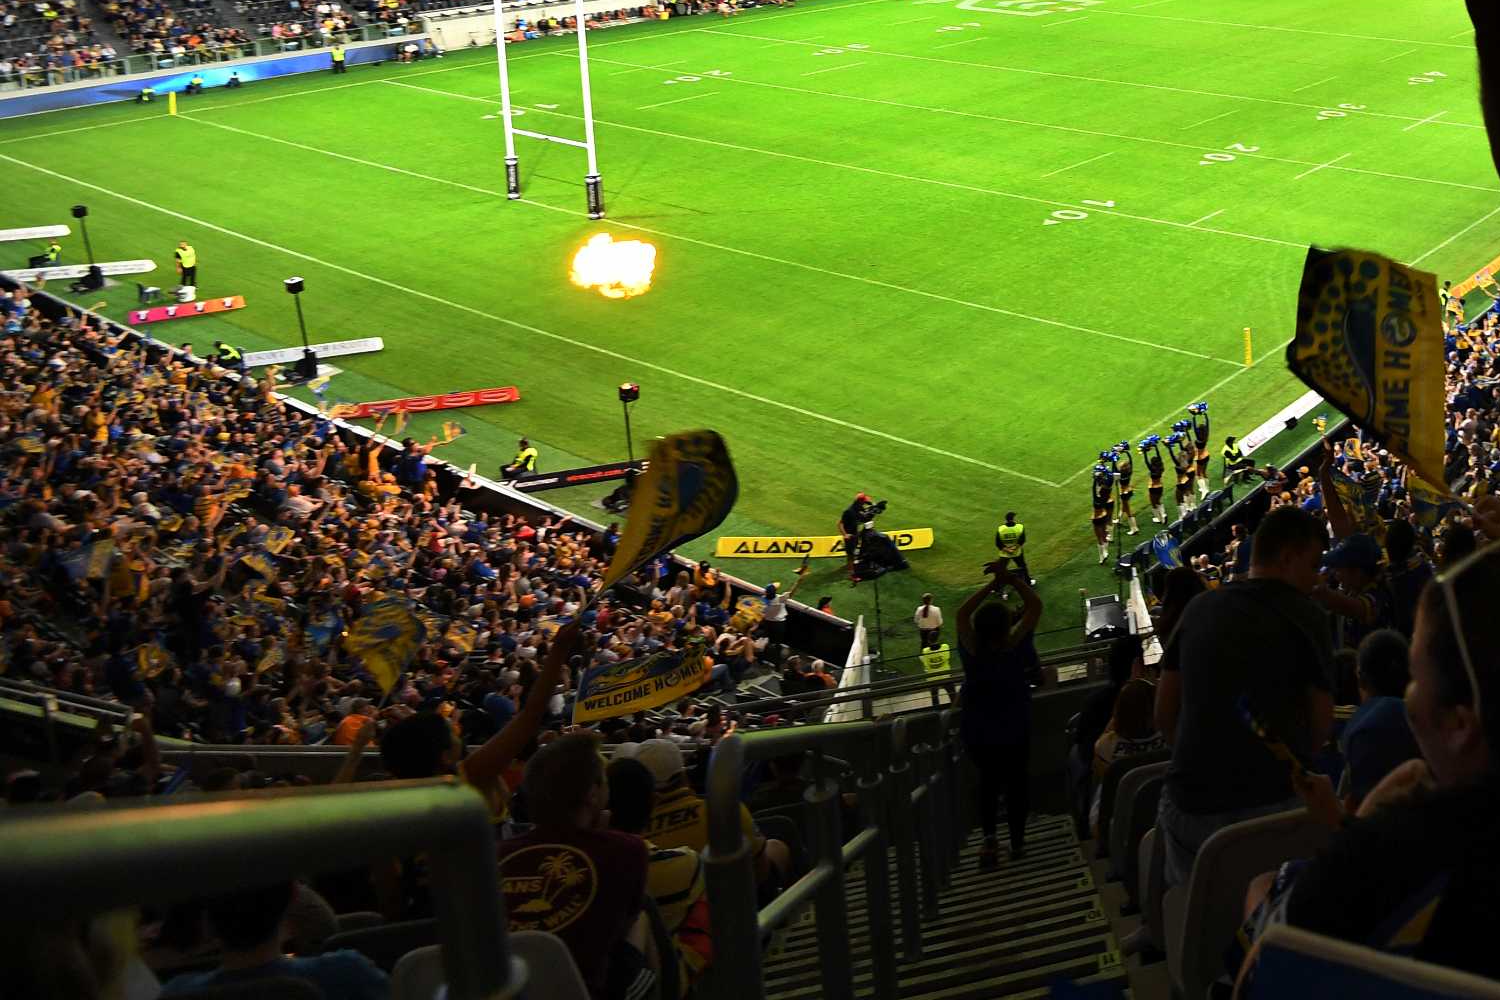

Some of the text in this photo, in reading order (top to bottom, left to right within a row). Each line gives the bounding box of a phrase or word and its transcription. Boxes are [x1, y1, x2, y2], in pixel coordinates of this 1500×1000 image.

[1203, 143, 1261, 161] 20
[1052, 200, 1115, 220] 10
[734, 540, 813, 553] ALAND
[584, 684, 650, 711] WELCOME
[502, 879, 543, 893] ANS
